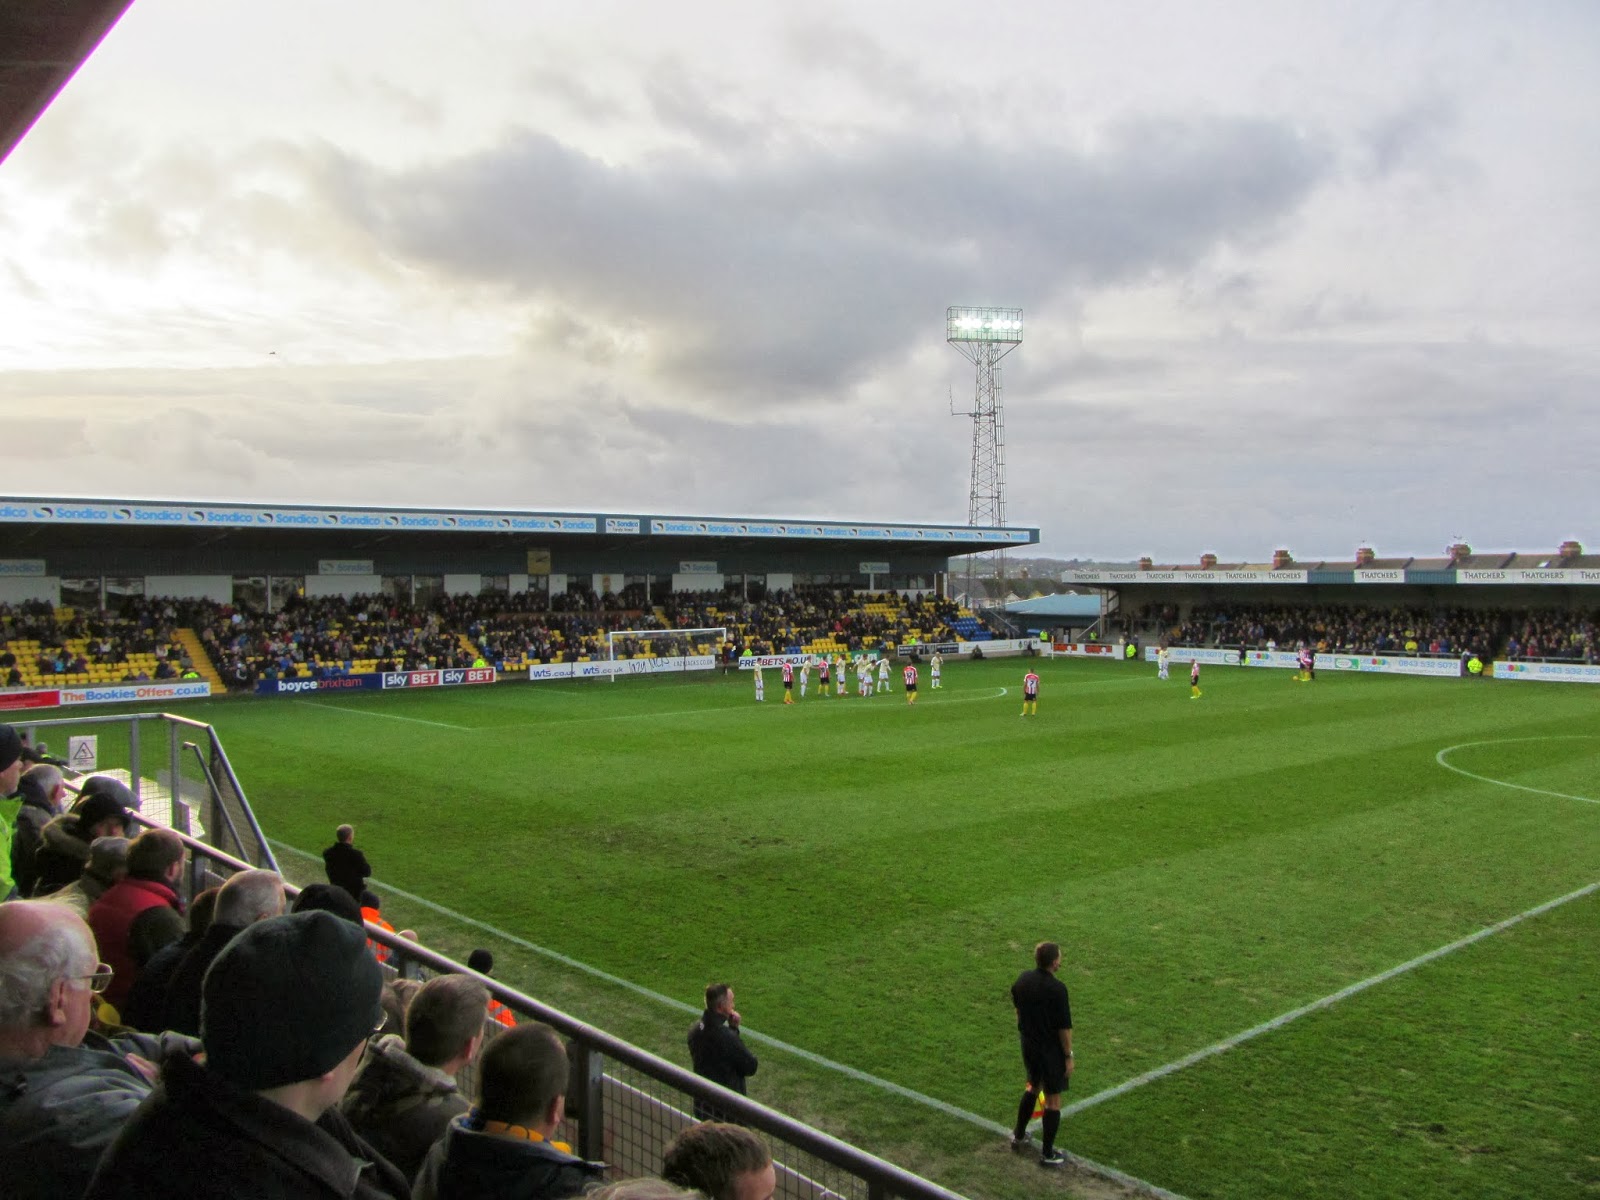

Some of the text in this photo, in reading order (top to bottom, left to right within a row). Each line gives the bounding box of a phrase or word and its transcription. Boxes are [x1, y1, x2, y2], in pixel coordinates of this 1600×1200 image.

[56, 508, 108, 519] Sondico
[135, 510, 182, 521] Sondico
[208, 512, 252, 522] Sondico
[276, 514, 318, 524] Sondico
[340, 515, 380, 525] Sondico
[401, 517, 438, 526] Sondico
[458, 518, 493, 527] Sondico
[512, 519, 545, 528] Sondico
[562, 521, 594, 529] Sondico
[665, 523, 693, 532] Sondico
[708, 524, 734, 533] Sondico
[748, 525, 774, 534] Sondico
[387, 672, 438, 686] sky BET
[445, 670, 492, 683] sky BET
[278, 677, 362, 692] boycebrixham
[63, 685, 208, 702] TheBookiesOffers.co.uk
